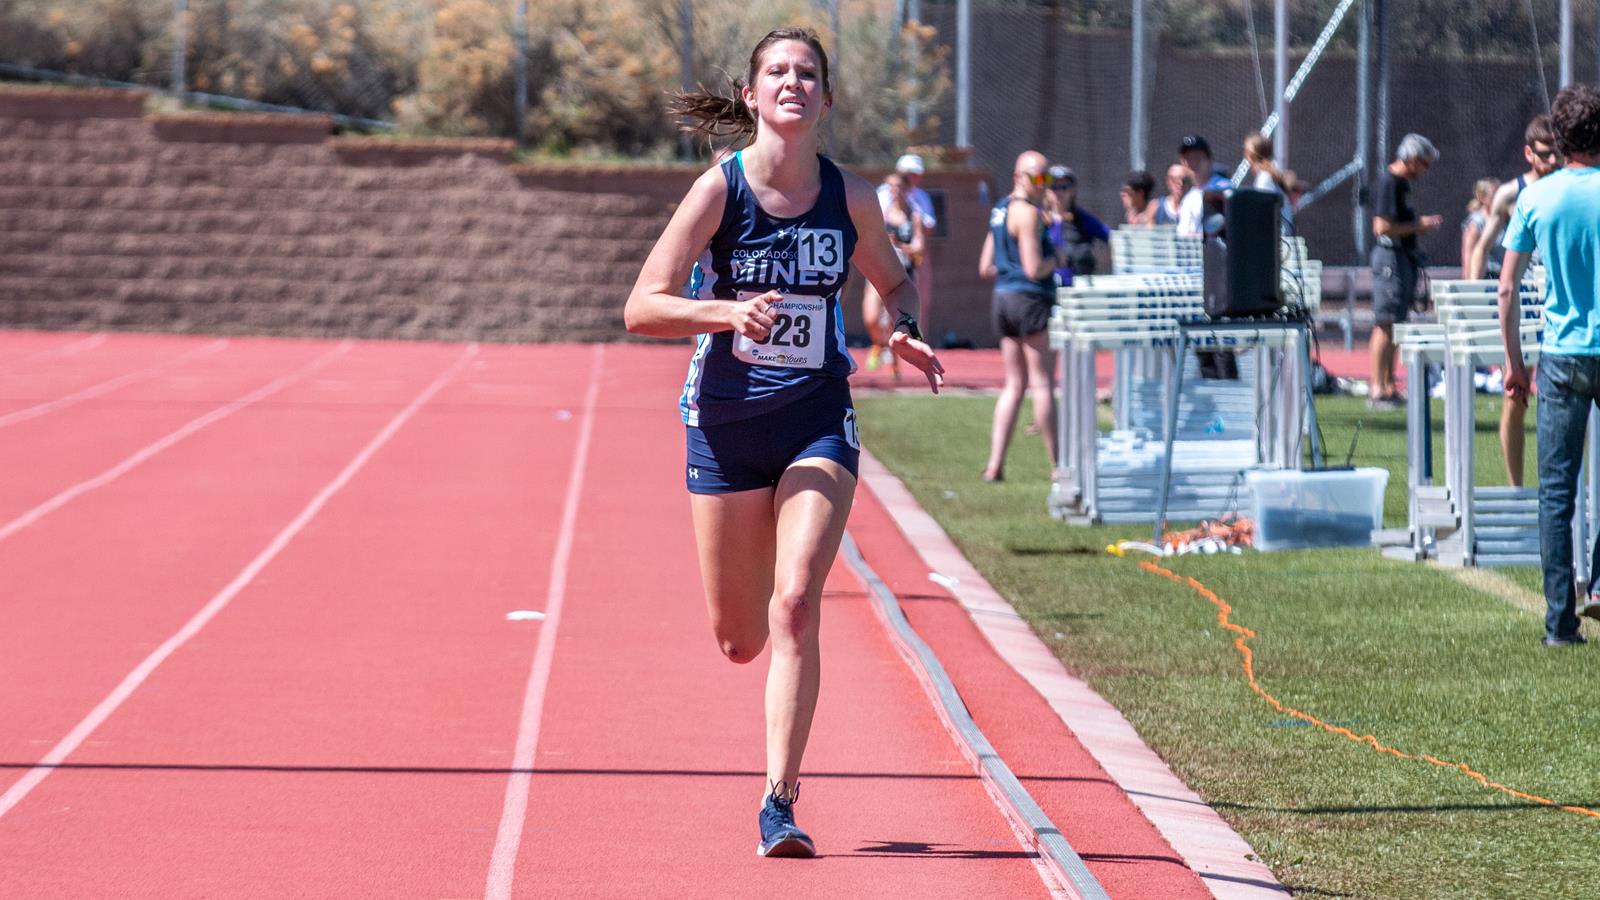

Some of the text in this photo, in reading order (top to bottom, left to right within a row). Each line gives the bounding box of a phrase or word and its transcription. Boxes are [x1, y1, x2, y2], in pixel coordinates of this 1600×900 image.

[801, 232, 838, 267] 13
[770, 302, 823, 311] HAMPIONSHIP
[753, 313, 811, 348] 23
